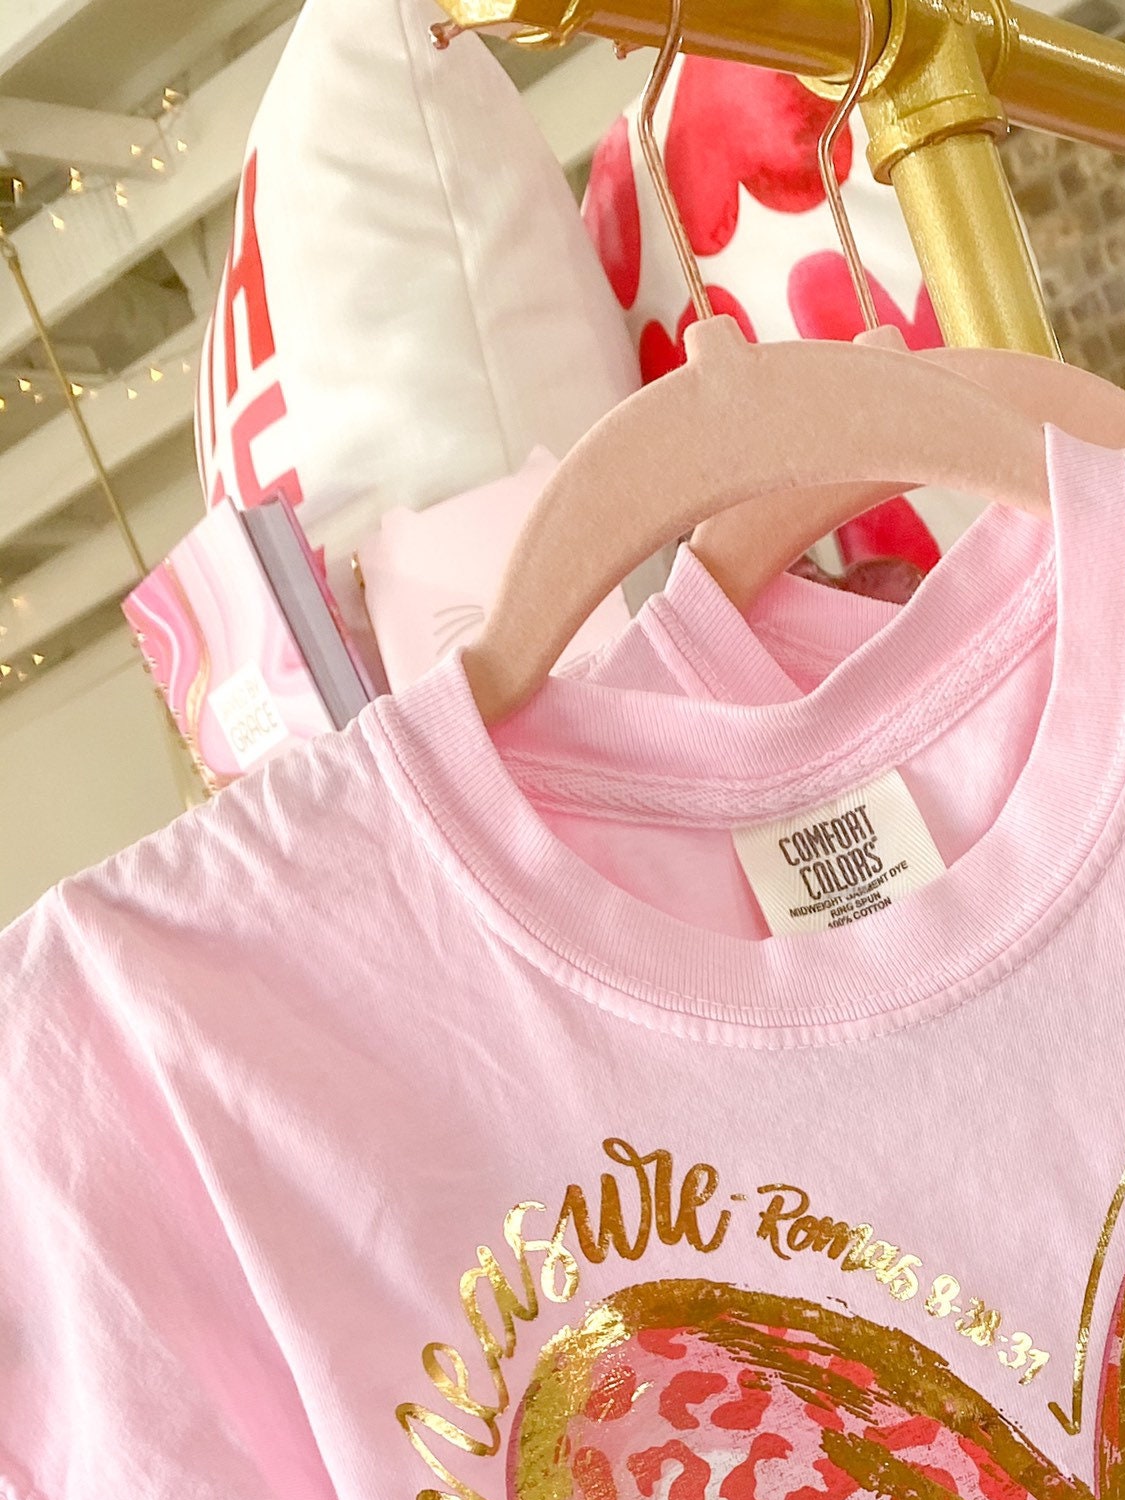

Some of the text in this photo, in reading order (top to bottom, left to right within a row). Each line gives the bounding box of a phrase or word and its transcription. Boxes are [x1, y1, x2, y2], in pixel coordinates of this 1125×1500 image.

[230, 701, 278, 752] GRACE
[778, 804, 875, 867] COMFORT
[788, 895, 843, 918] MIDWEIGHT
[889, 859, 908, 878] DYE
[799, 841, 883, 901] COLORS
[830, 891, 881, 918] RING SPUN
[853, 896, 892, 920] COTTON
